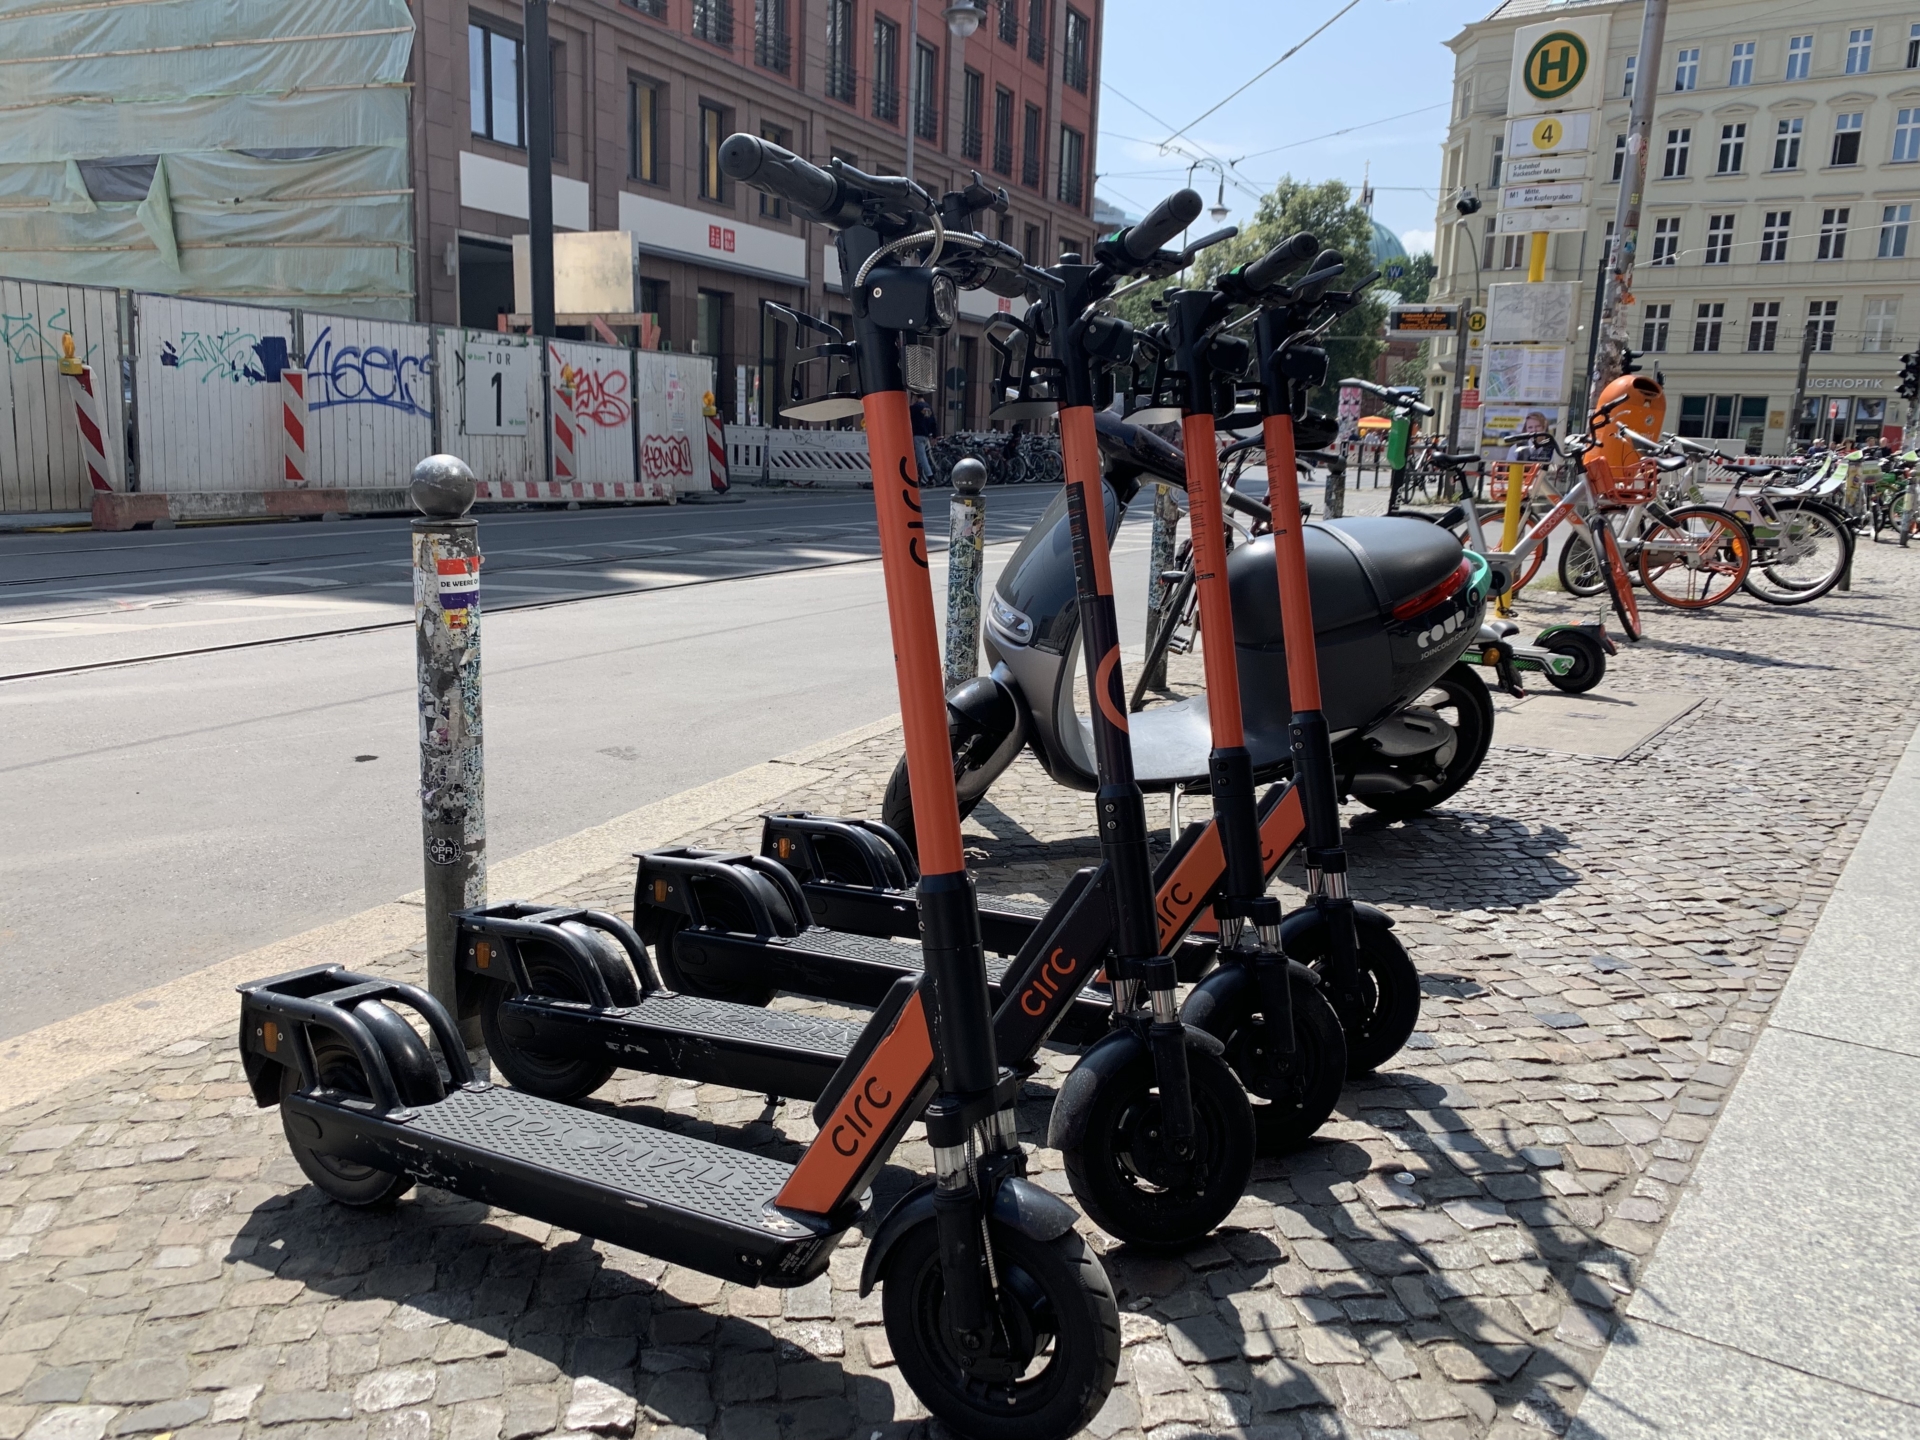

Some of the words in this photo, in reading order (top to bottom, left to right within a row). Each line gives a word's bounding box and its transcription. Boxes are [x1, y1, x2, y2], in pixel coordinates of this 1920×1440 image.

[1538, 46, 1570, 85] H
[1541, 124, 1553, 143] 4
[1513, 161, 1541, 171] S-Bahnhof
[1513, 169, 1542, 177] Hackescher
[1509, 191, 1519, 199] M1
[1534, 194, 1573, 202] Kupfergraben
[1472, 316, 1482, 328] H
[488, 351, 511, 366] TOR
[1806, 378, 1883, 389] UGENOPTIK
[491, 372, 502, 427] 1
[1417, 610, 1466, 648] coup
[1157, 882, 1193, 940] irc
[1021, 947, 1076, 1016] circ
[831, 1076, 892, 1157] circ
